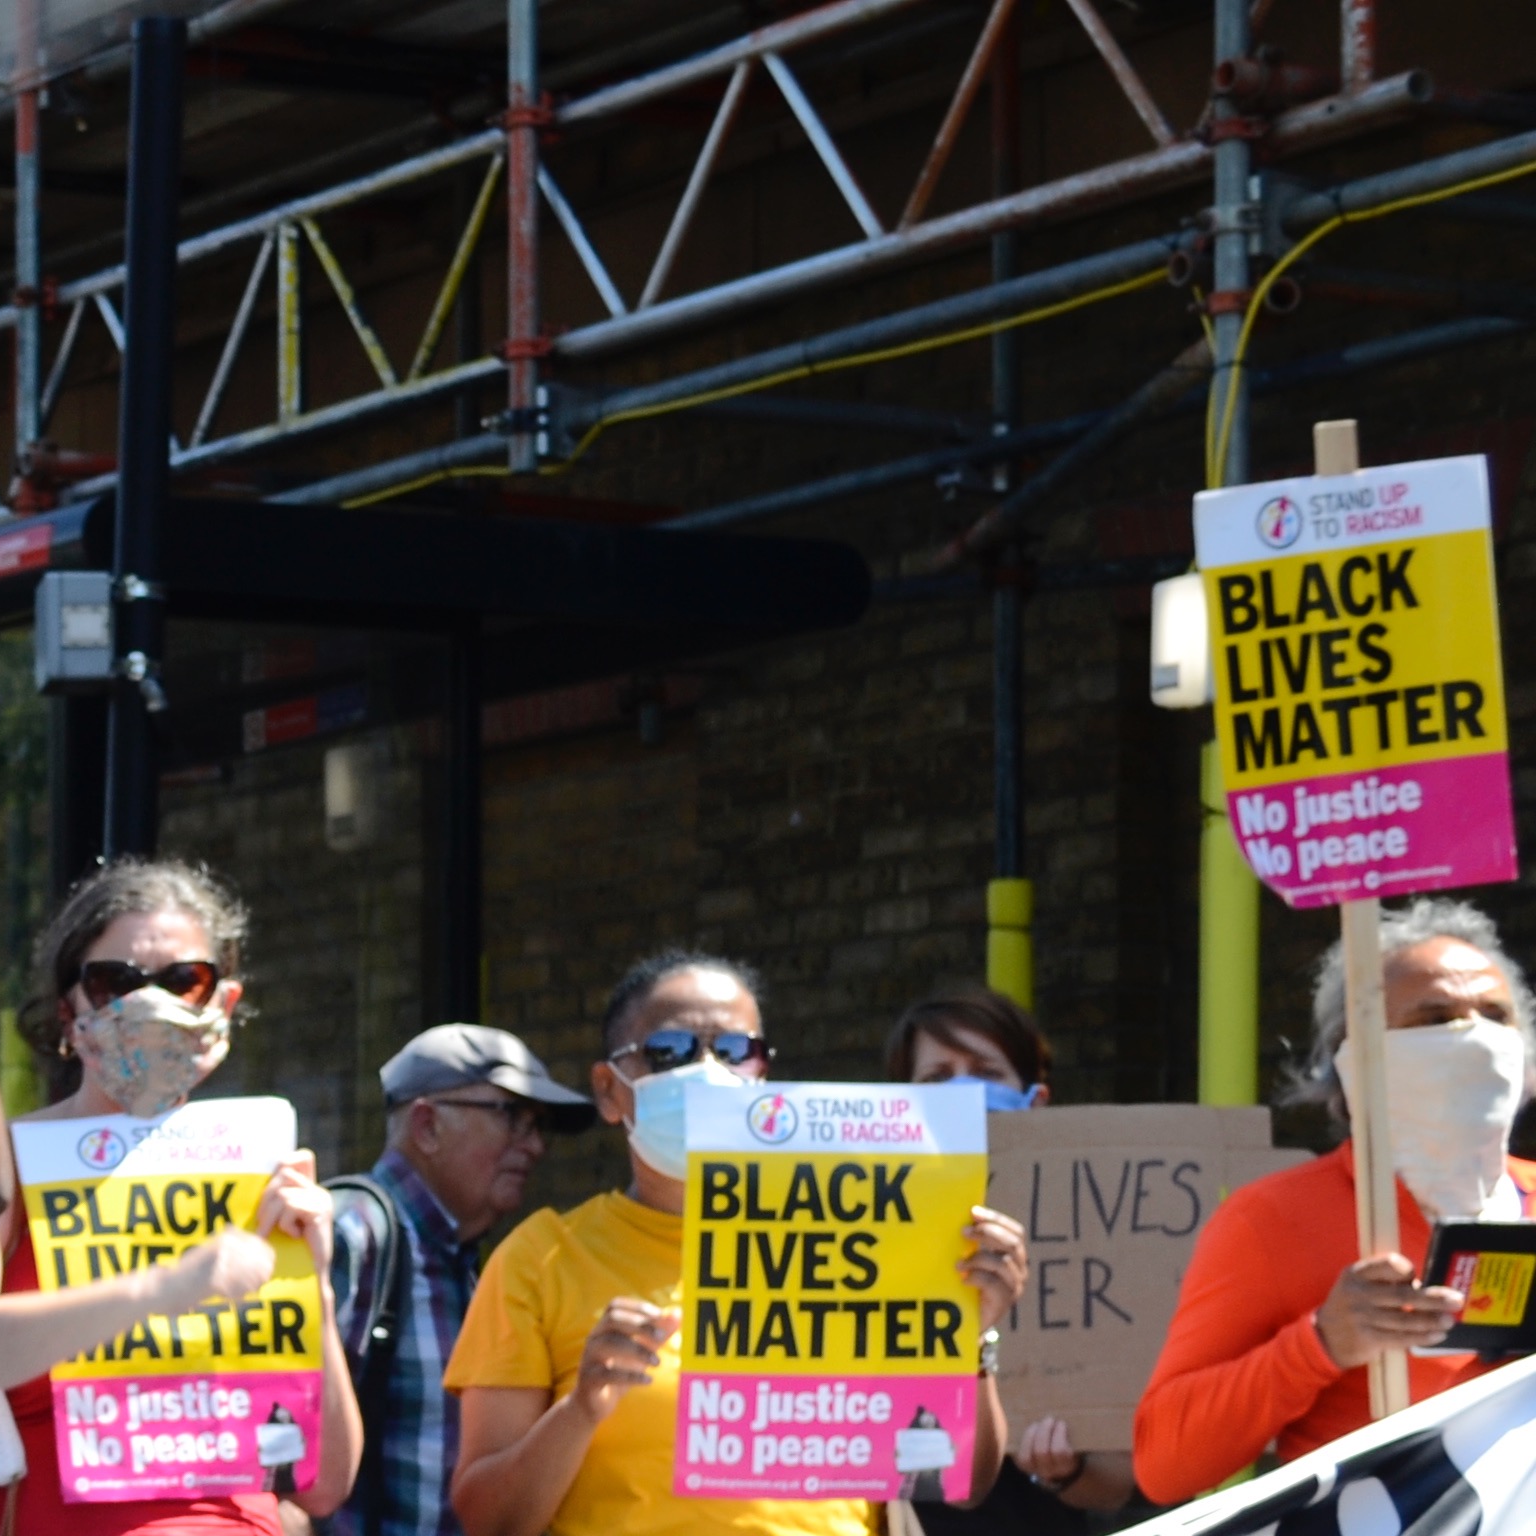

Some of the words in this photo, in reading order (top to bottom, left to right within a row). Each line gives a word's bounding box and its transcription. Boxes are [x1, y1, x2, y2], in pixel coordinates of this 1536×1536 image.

[1309, 487, 1375, 516] STAND
[1380, 483, 1409, 506] UP
[1311, 518, 1340, 540] TO
[1345, 505, 1423, 536] RACISM
[1218, 548, 1419, 635] BLACK
[1225, 623, 1392, 703] LIVES
[1231, 680, 1488, 772] MATTER
[1236, 795, 1287, 837] No
[1294, 776, 1423, 838] justice
[1246, 839, 1292, 878] No
[1298, 826, 1409, 879] peace
[806, 1098, 874, 1119] STAND
[880, 1099, 910, 1119] UP
[806, 1121, 836, 1142] TO
[840, 1122, 923, 1143] RACISM
[41, 1181, 237, 1239] BLACK
[699, 1161, 914, 1223] BLACK
[1030, 1158, 1202, 1243] LIVES
[696, 1231, 880, 1292] LIVES
[694, 1299, 963, 1360] MATTER
[64, 1385, 120, 1426] No
[126, 1379, 252, 1431] justice
[687, 1380, 746, 1422] No
[751, 1381, 893, 1431] justice
[69, 1428, 124, 1468] No
[129, 1431, 239, 1474] peace
[686, 1423, 744, 1464] No
[752, 1432, 873, 1475] peace
